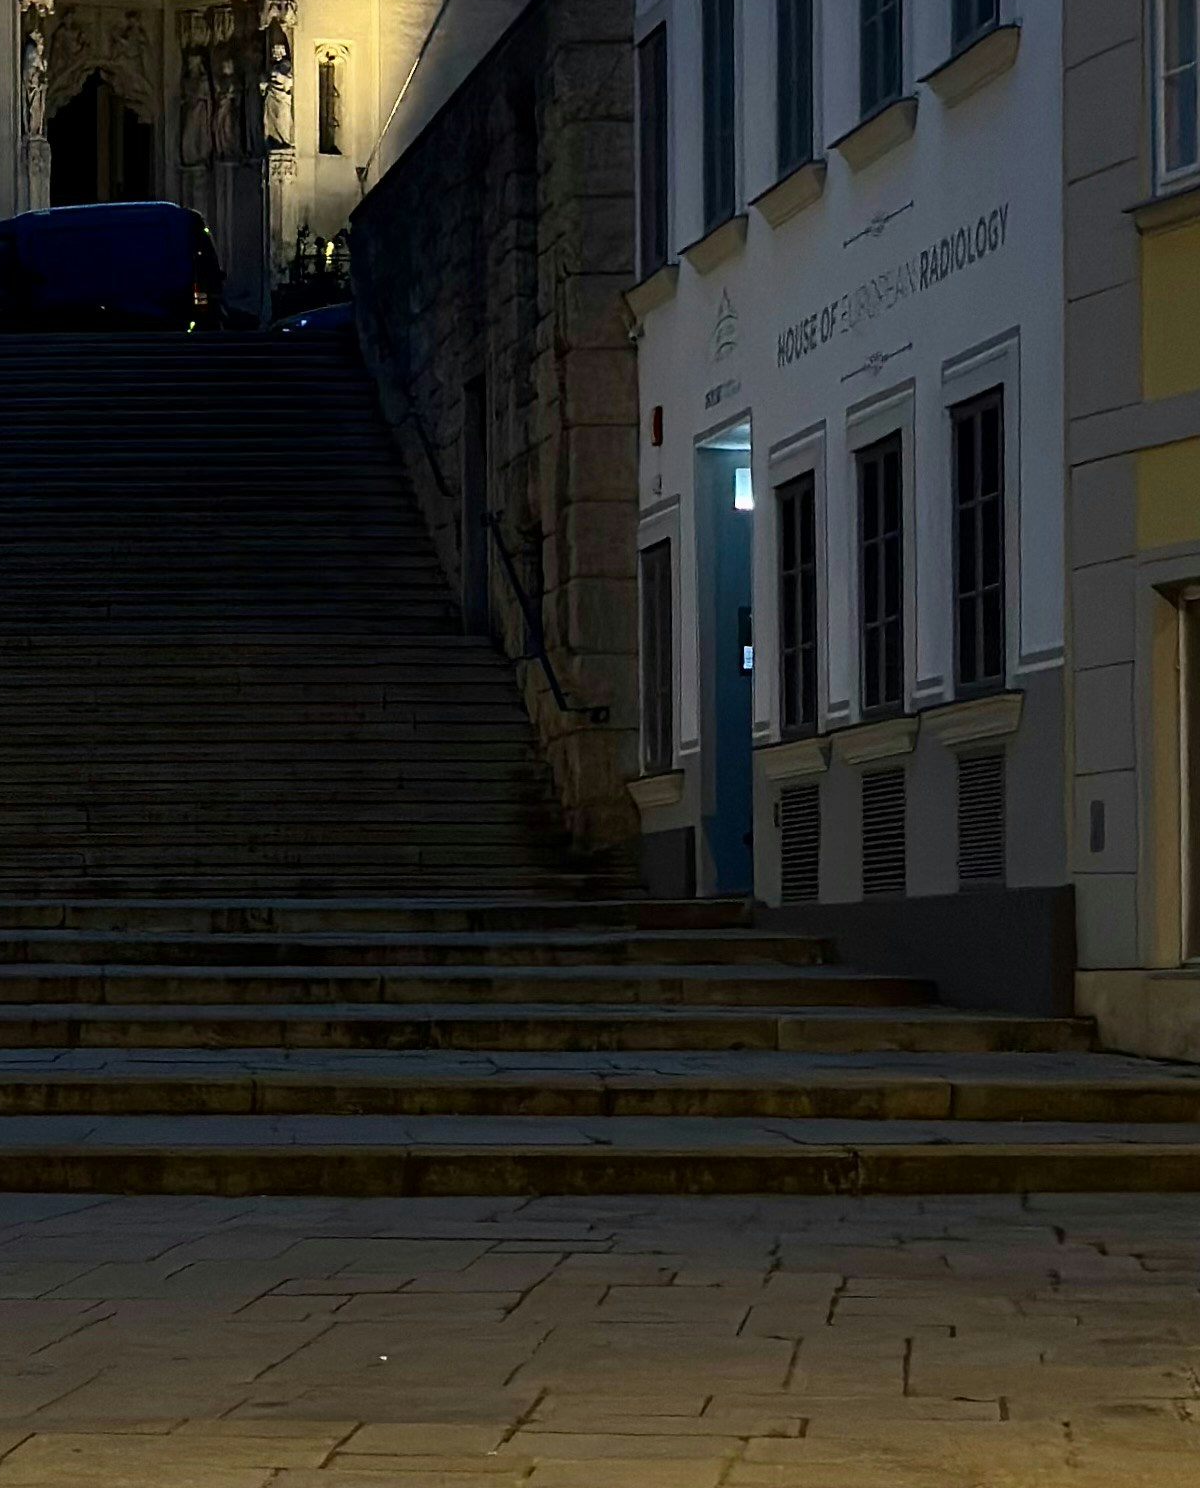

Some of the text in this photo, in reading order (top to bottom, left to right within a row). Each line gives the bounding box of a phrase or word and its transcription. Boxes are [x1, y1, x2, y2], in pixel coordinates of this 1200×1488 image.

[777, 312, 818, 368] HOUSE
[821, 299, 839, 344] OF
[919, 202, 1009, 292] RADIOLOGY
